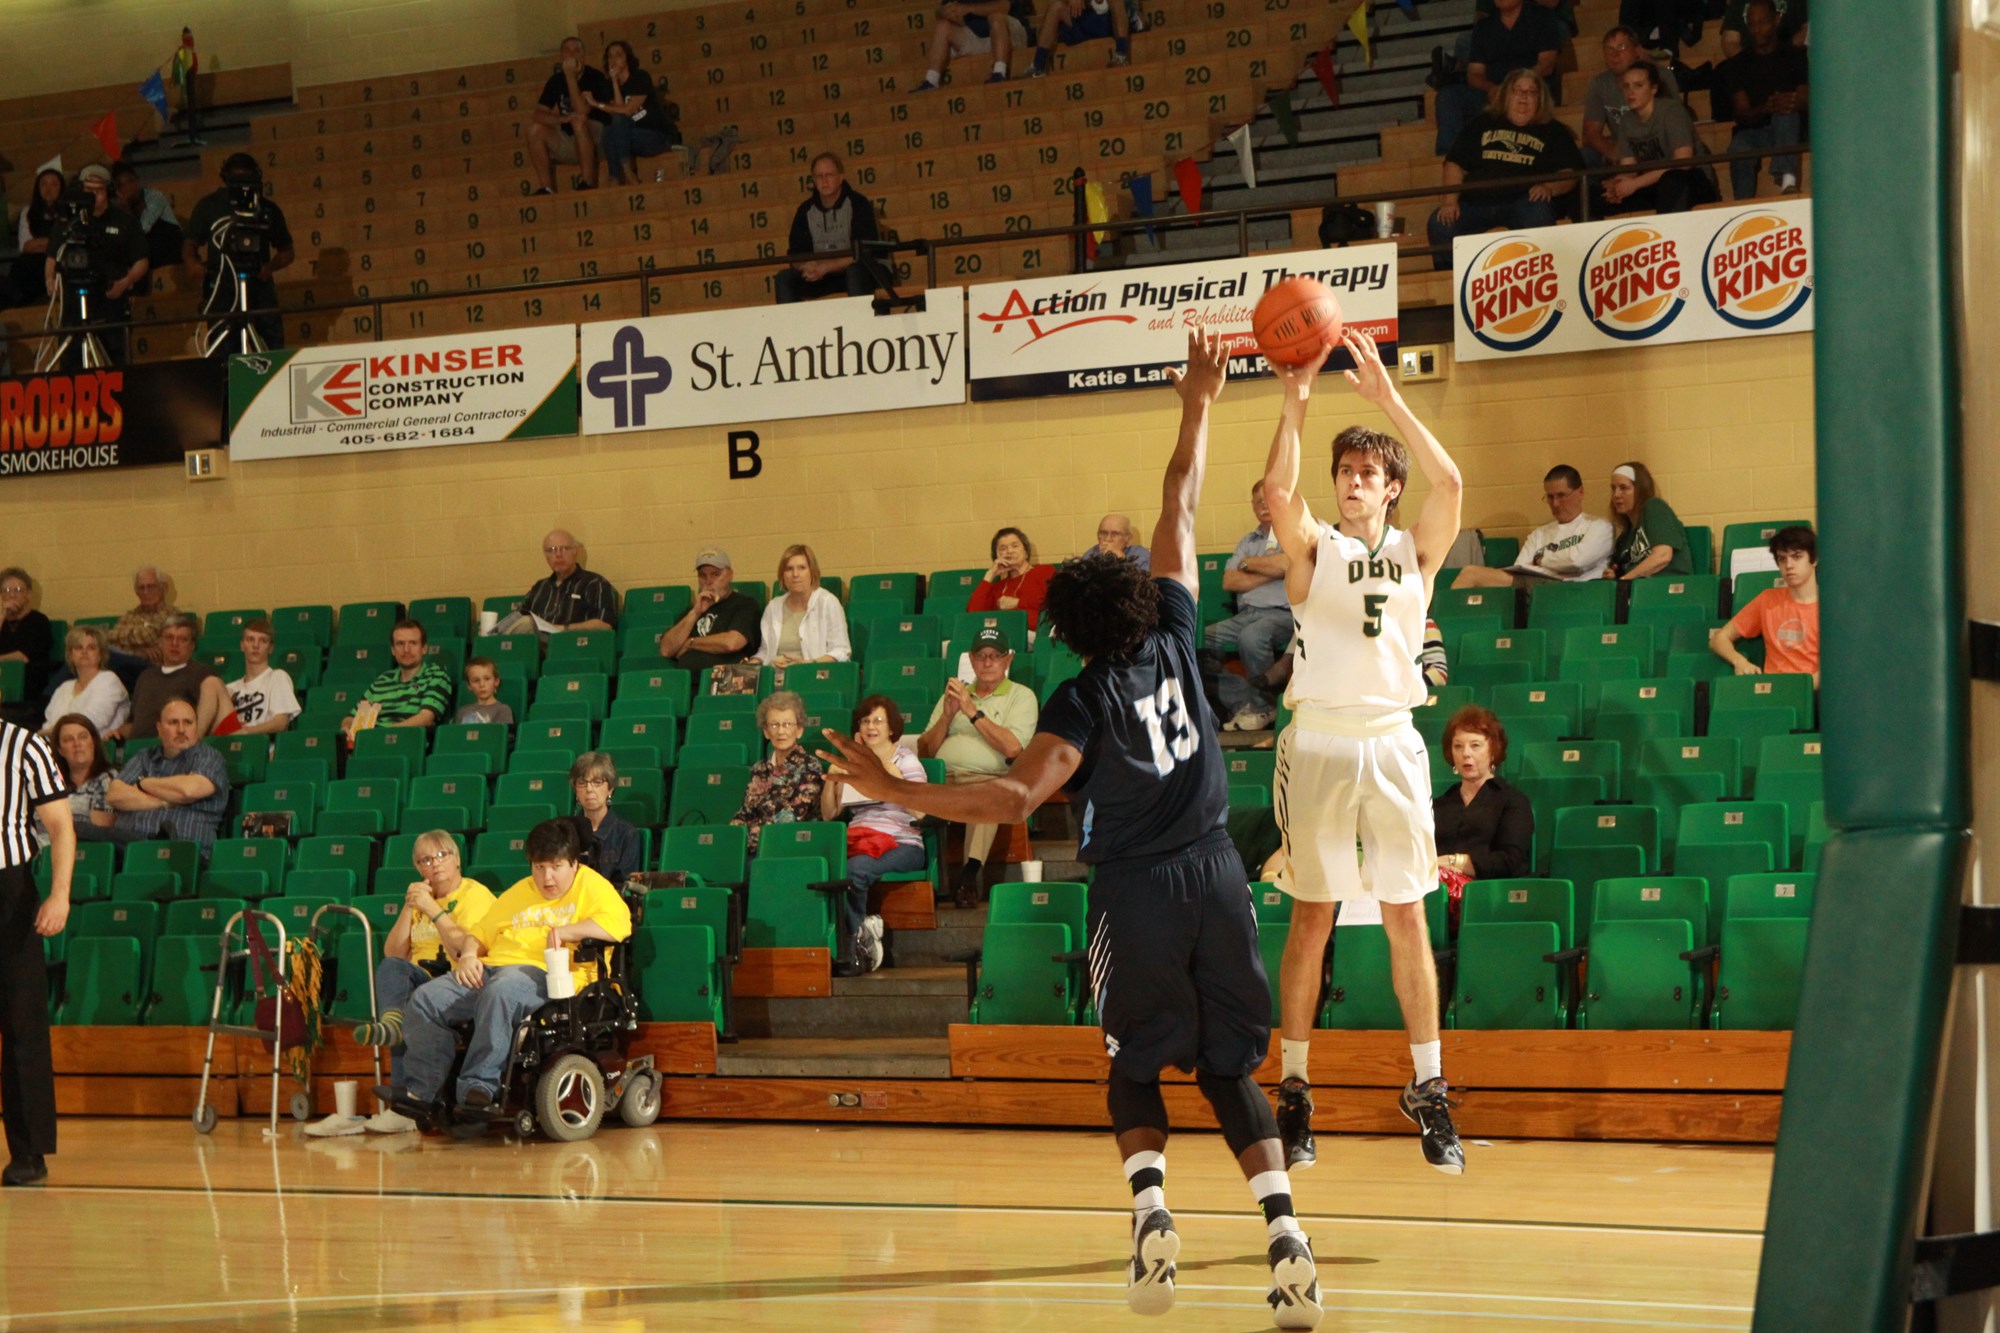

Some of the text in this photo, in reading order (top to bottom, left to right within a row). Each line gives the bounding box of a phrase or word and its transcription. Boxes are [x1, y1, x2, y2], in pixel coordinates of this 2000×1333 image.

[746, 9, 754, 22] 4
[796, 1, 805, 16] 5
[1207, 3, 1225, 18] 19
[696, 16, 705, 31] 3
[907, 13, 924, 29] 13
[1147, 10, 1165, 26] 18
[647, 22, 656, 38] 2
[802, 28, 815, 44] 11
[855, 21, 869, 36] 12
[1290, 23, 1306, 41] 21
[751, 35, 767, 50] 10
[1227, 29, 1251, 48] 20
[702, 43, 712, 58] 9
[1168, 39, 1185, 55] 19
[652, 49, 662, 64] 8
[813, 54, 828, 70] 12
[866, 48, 883, 63] 13
[506, 69, 515, 83] 5
[708, 69, 723, 83] 10
[760, 63, 772, 76] 11
[1185, 66, 1211, 85] 20
[1250, 60, 1266, 78] 21
[411, 81, 419, 96] 3
[458, 75, 467, 89] 4
[879, 77, 895, 91] 14
[1126, 75, 1144, 92] 19
[364, 87, 373, 102] 2
[770, 89, 785, 105] 12
[824, 83, 840, 99] 13
[1006, 90, 1023, 107] 17
[1066, 83, 1084, 100] 18
[716, 97, 729, 112] 11
[948, 97, 965, 113] 16
[1144, 101, 1170, 120] 20
[1209, 95, 1226, 113] 21
[834, 112, 851, 128] 14
[890, 104, 908, 121] 15
[1085, 111, 1103, 127] 19
[513, 123, 520, 137] 7
[777, 118, 794, 135] 13
[964, 124, 980, 141] 17
[1024, 117, 1042, 134] 18
[413, 135, 422, 150] 5
[847, 139, 864, 156] 15
[905, 132, 922, 149] 16
[1100, 138, 1125, 157] 20
[1165, 132, 1182, 151] 21
[514, 152, 524, 167] 8
[735, 153, 751, 169] 13
[790, 147, 807, 162] 14
[977, 154, 996, 171] 18
[1039, 147, 1057, 164] 19
[412, 164, 421, 179] 6
[464, 158, 471, 173] 7
[917, 160, 934, 178] 17
[362, 170, 372, 185] 5
[858, 168, 875, 184] 16
[468, 186, 479, 201] 8
[741, 182, 759, 198] 14
[992, 185, 1011, 202] 19
[1054, 176, 1076, 196] 20
[417, 192, 425, 206] 7
[629, 194, 644, 211] 12
[684, 188, 702, 205] 13
[930, 192, 949, 209] 18
[365, 198, 375, 213] 6
[574, 201, 587, 217] 11
[468, 213, 479, 229] 9
[520, 207, 537, 223] 10
[750, 211, 767, 228] 15
[1005, 215, 1032, 231] 20
[364, 224, 372, 240] 7
[415, 219, 426, 235] 8
[634, 224, 651, 240] 13
[691, 218, 709, 234] 14
[943, 223, 962, 238] 19
[522, 237, 535, 253] 11
[578, 230, 593, 247] 12
[415, 249, 425, 265] 9
[467, 242, 485, 259] 10
[697, 249, 715, 265] 15
[757, 242, 775, 259] 16
[1713, 227, 1804, 278] BURGER
[361, 255, 372, 271] 8
[638, 256, 656, 271] 14
[955, 254, 982, 274] 20
[1023, 249, 1041, 269] 21
[1590, 239, 1677, 290] BURGER
[523, 267, 539, 283] 12
[580, 261, 598, 277] 13
[1471, 253, 1555, 300] BURGER
[466, 274, 481, 288] 11
[1718, 247, 1807, 308] KING
[411, 279, 429, 295] 10
[703, 280, 722, 298] 16
[1593, 260, 1681, 320] KING
[524, 299, 542, 316] 13
[582, 293, 601, 311] 14
[978, 287, 1107, 341] Action
[1120, 271, 1249, 311] Physical
[1474, 272, 1558, 331] KING
[410, 311, 423, 328] 11
[467, 305, 483, 322] 12
[1148, 304, 1255, 331] and Rehabilita
[353, 316, 372, 334] 10
[369, 344, 524, 379] KINSER
[691, 326, 959, 392] St. Anthony
[369, 371, 525, 396] CONSTRUCTION
[1068, 370, 1127, 389] Katie
[369, 392, 464, 411] COMPANY
[0, 370, 123, 451] ROBB'S
[261, 407, 527, 438] Industrial Commercial General Contractors
[0, 445, 119, 475] SMOKEHOUSE
[727, 429, 762, 480] B
[1348, 557, 1402, 584] OBU
[1363, 594, 1389, 638] 5
